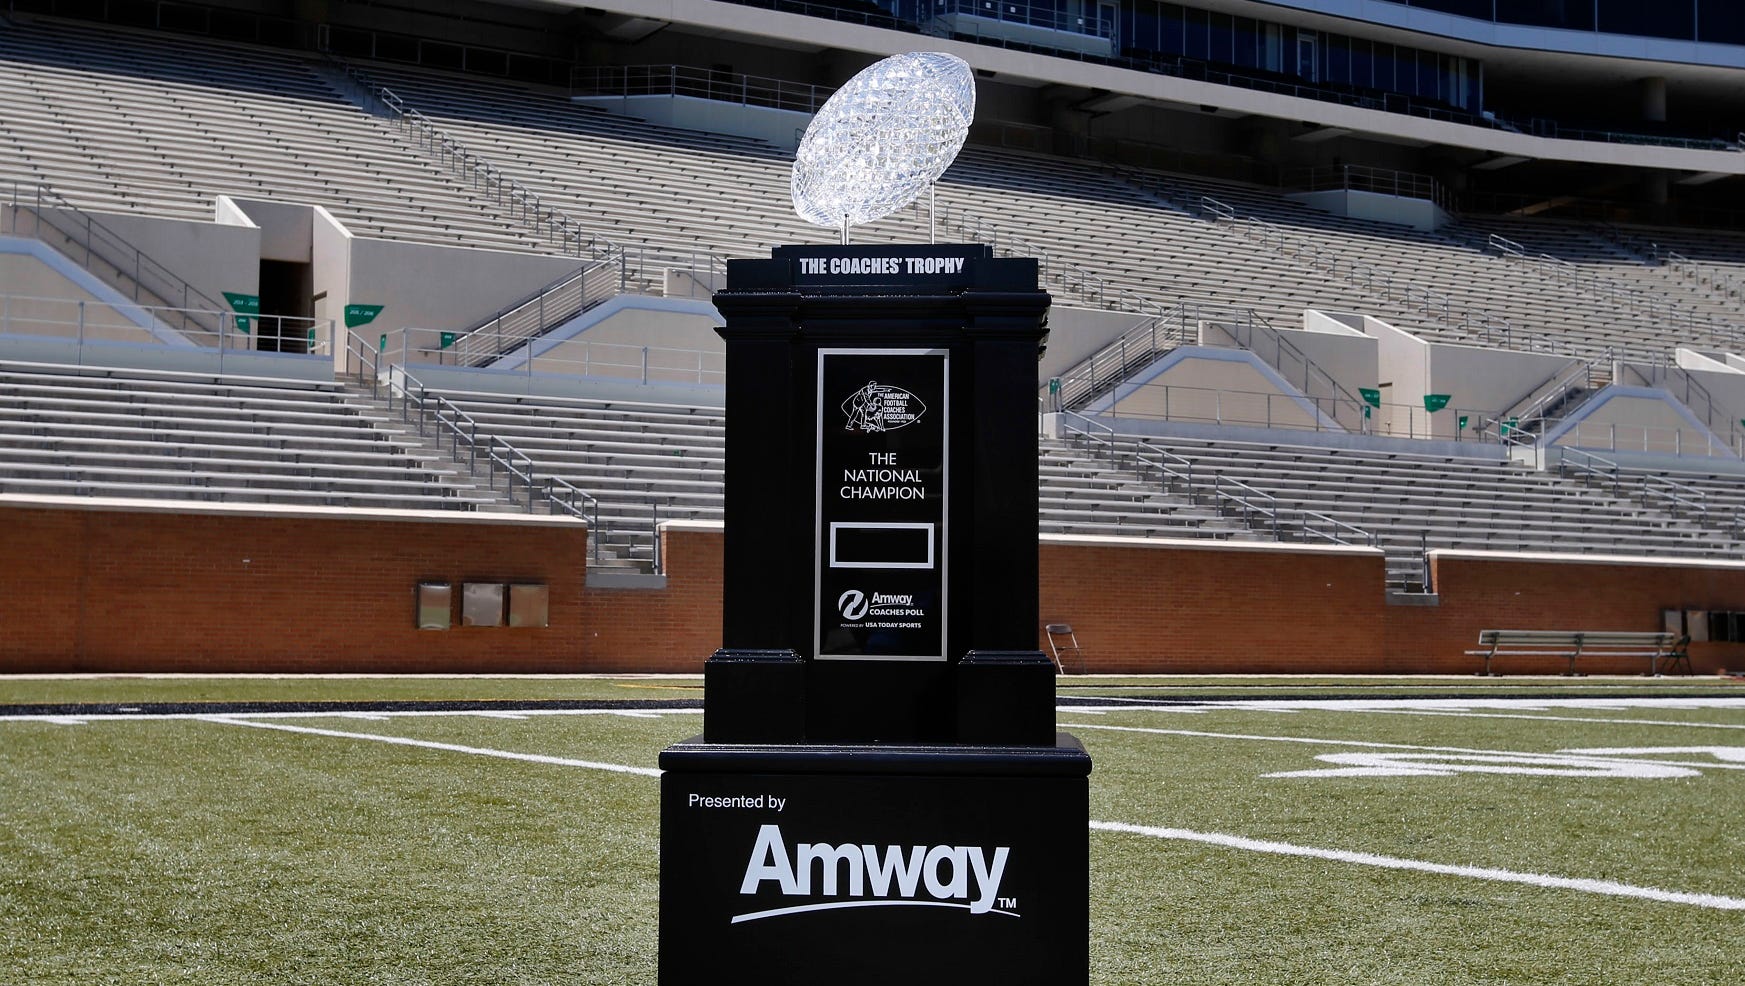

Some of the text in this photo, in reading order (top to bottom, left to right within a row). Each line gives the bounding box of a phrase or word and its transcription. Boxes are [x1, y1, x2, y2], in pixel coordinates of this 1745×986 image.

[800, 258, 827, 274] THE
[905, 258, 964, 274] TROPHY
[869, 452, 896, 465] THE
[844, 469, 922, 482] NATIONAL
[840, 486, 925, 499] CHAMPION
[871, 592, 913, 606] Amway
[869, 608, 904, 616] COACHES
[688, 793, 786, 812] Presented by
[740, 824, 1010, 914] Amway
